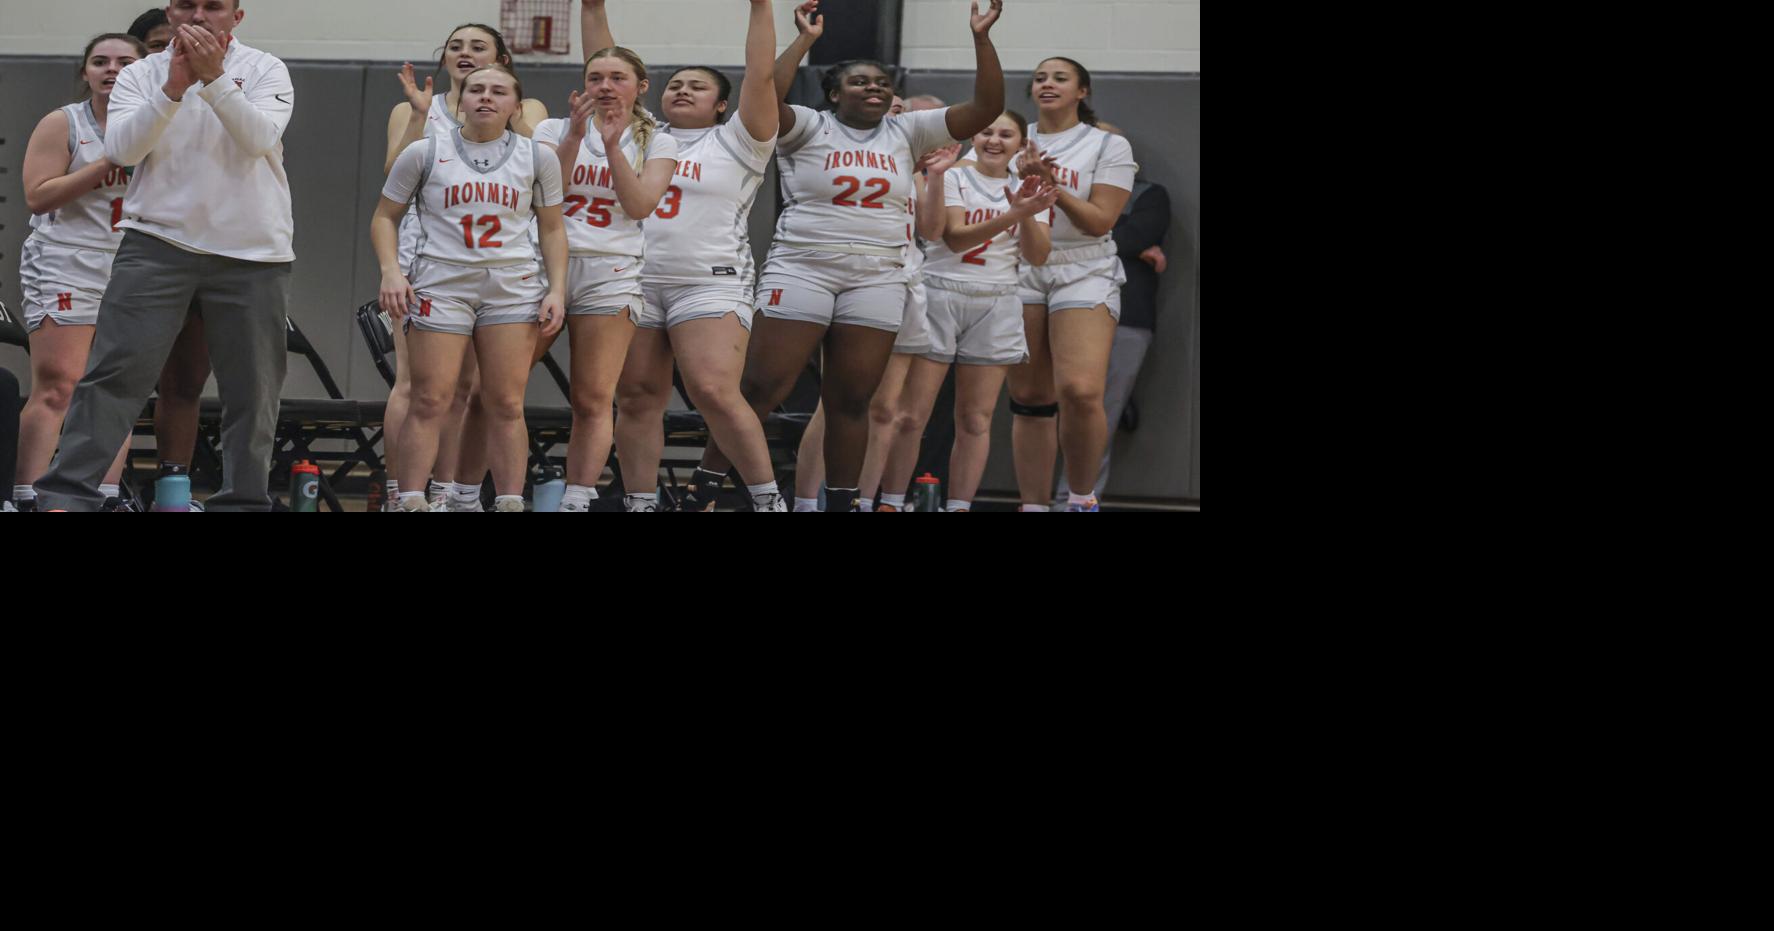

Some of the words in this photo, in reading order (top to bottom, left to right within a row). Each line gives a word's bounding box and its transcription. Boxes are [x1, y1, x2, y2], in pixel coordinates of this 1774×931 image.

[824, 149, 898, 176] IRONMEN
[444, 181, 519, 212] IRONMEN
[655, 185, 682, 219] 3
[832, 175, 891, 209] 22
[563, 194, 616, 228] 25
[460, 214, 503, 249] 12
[57, 292, 72, 311] N
[768, 288, 783, 306] N
